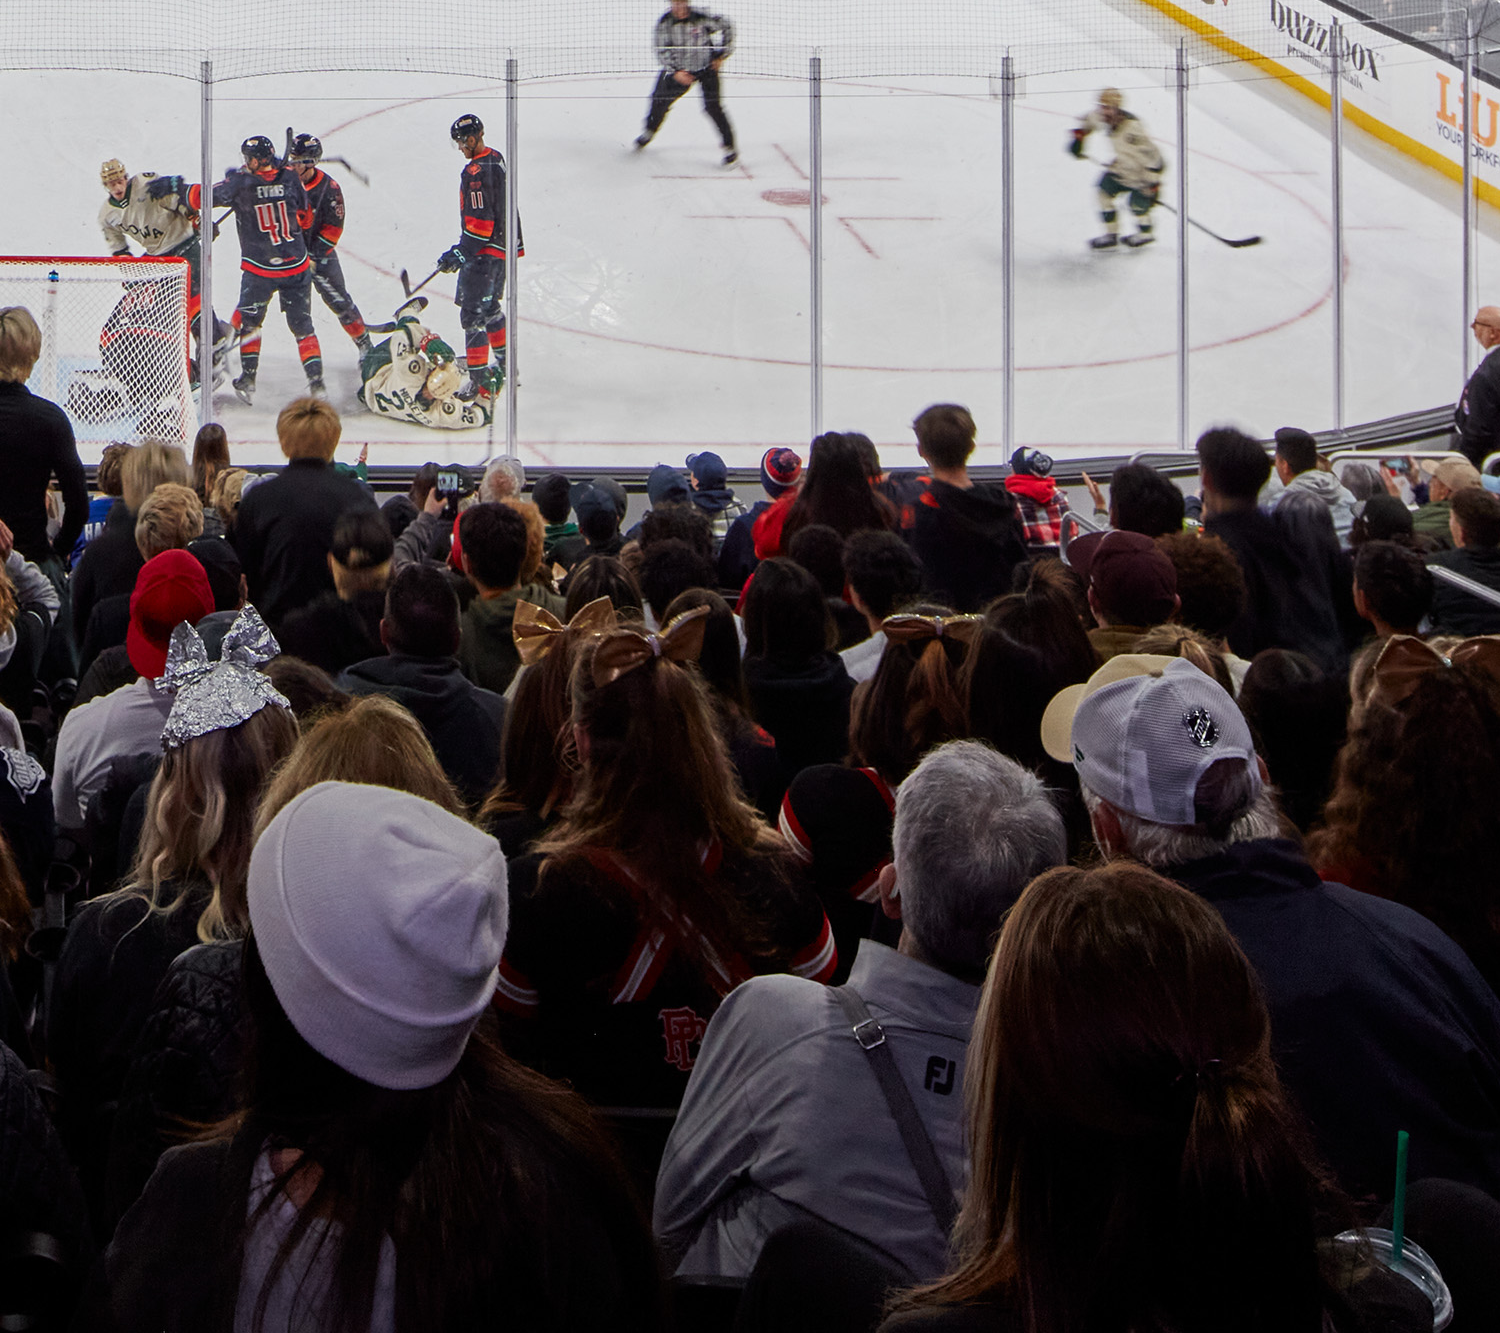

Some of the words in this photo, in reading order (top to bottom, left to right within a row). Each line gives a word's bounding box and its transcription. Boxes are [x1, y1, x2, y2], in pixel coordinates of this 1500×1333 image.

[1436, 120, 1464, 149] YOUR
[257, 185, 285, 199] EVANS
[470, 191, 484, 209] 11
[118, 222, 165, 241] IOWA
[254, 200, 295, 247] 41
[399, 387, 433, 426] HICKETTS
[924, 1055, 956, 1096] FJ
